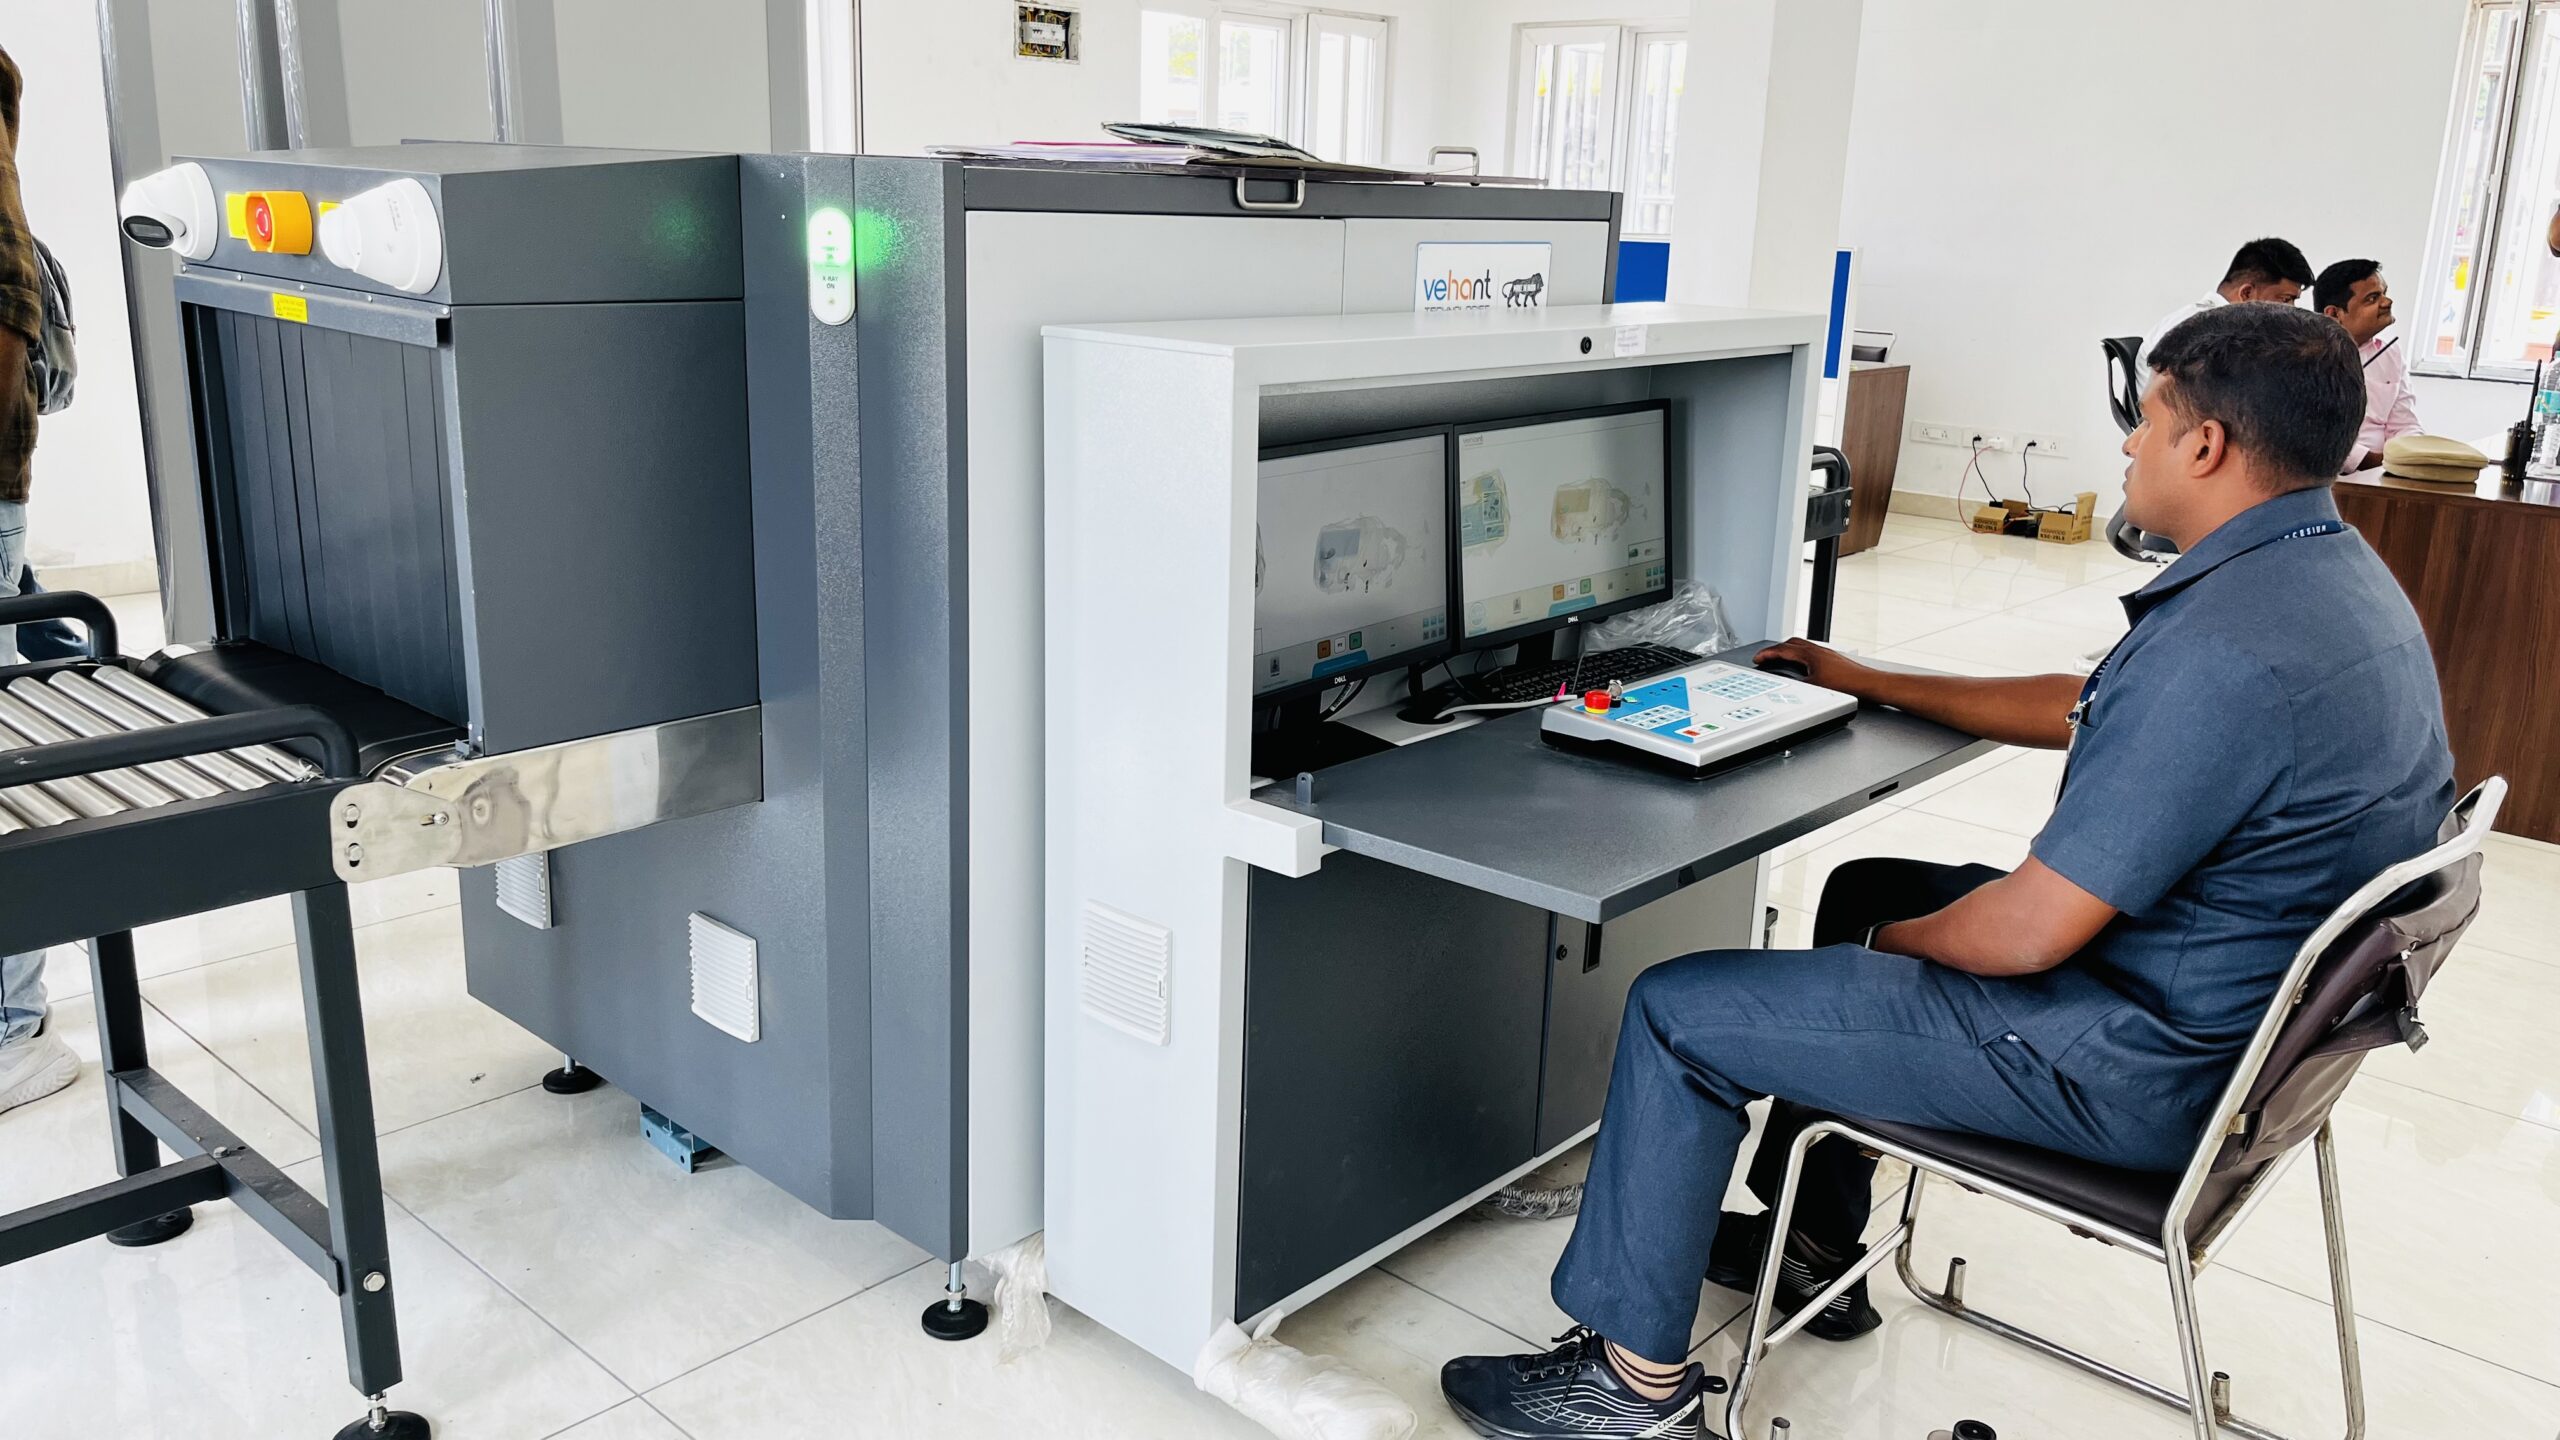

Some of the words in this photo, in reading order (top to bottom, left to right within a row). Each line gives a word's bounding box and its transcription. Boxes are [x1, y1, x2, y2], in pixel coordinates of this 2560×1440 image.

[1424, 268, 1491, 301] vehant
[1567, 616, 1578, 624] DELL
[1334, 675, 1347, 684] DELL
[1657, 1409, 1688, 1430] CAMPUS
